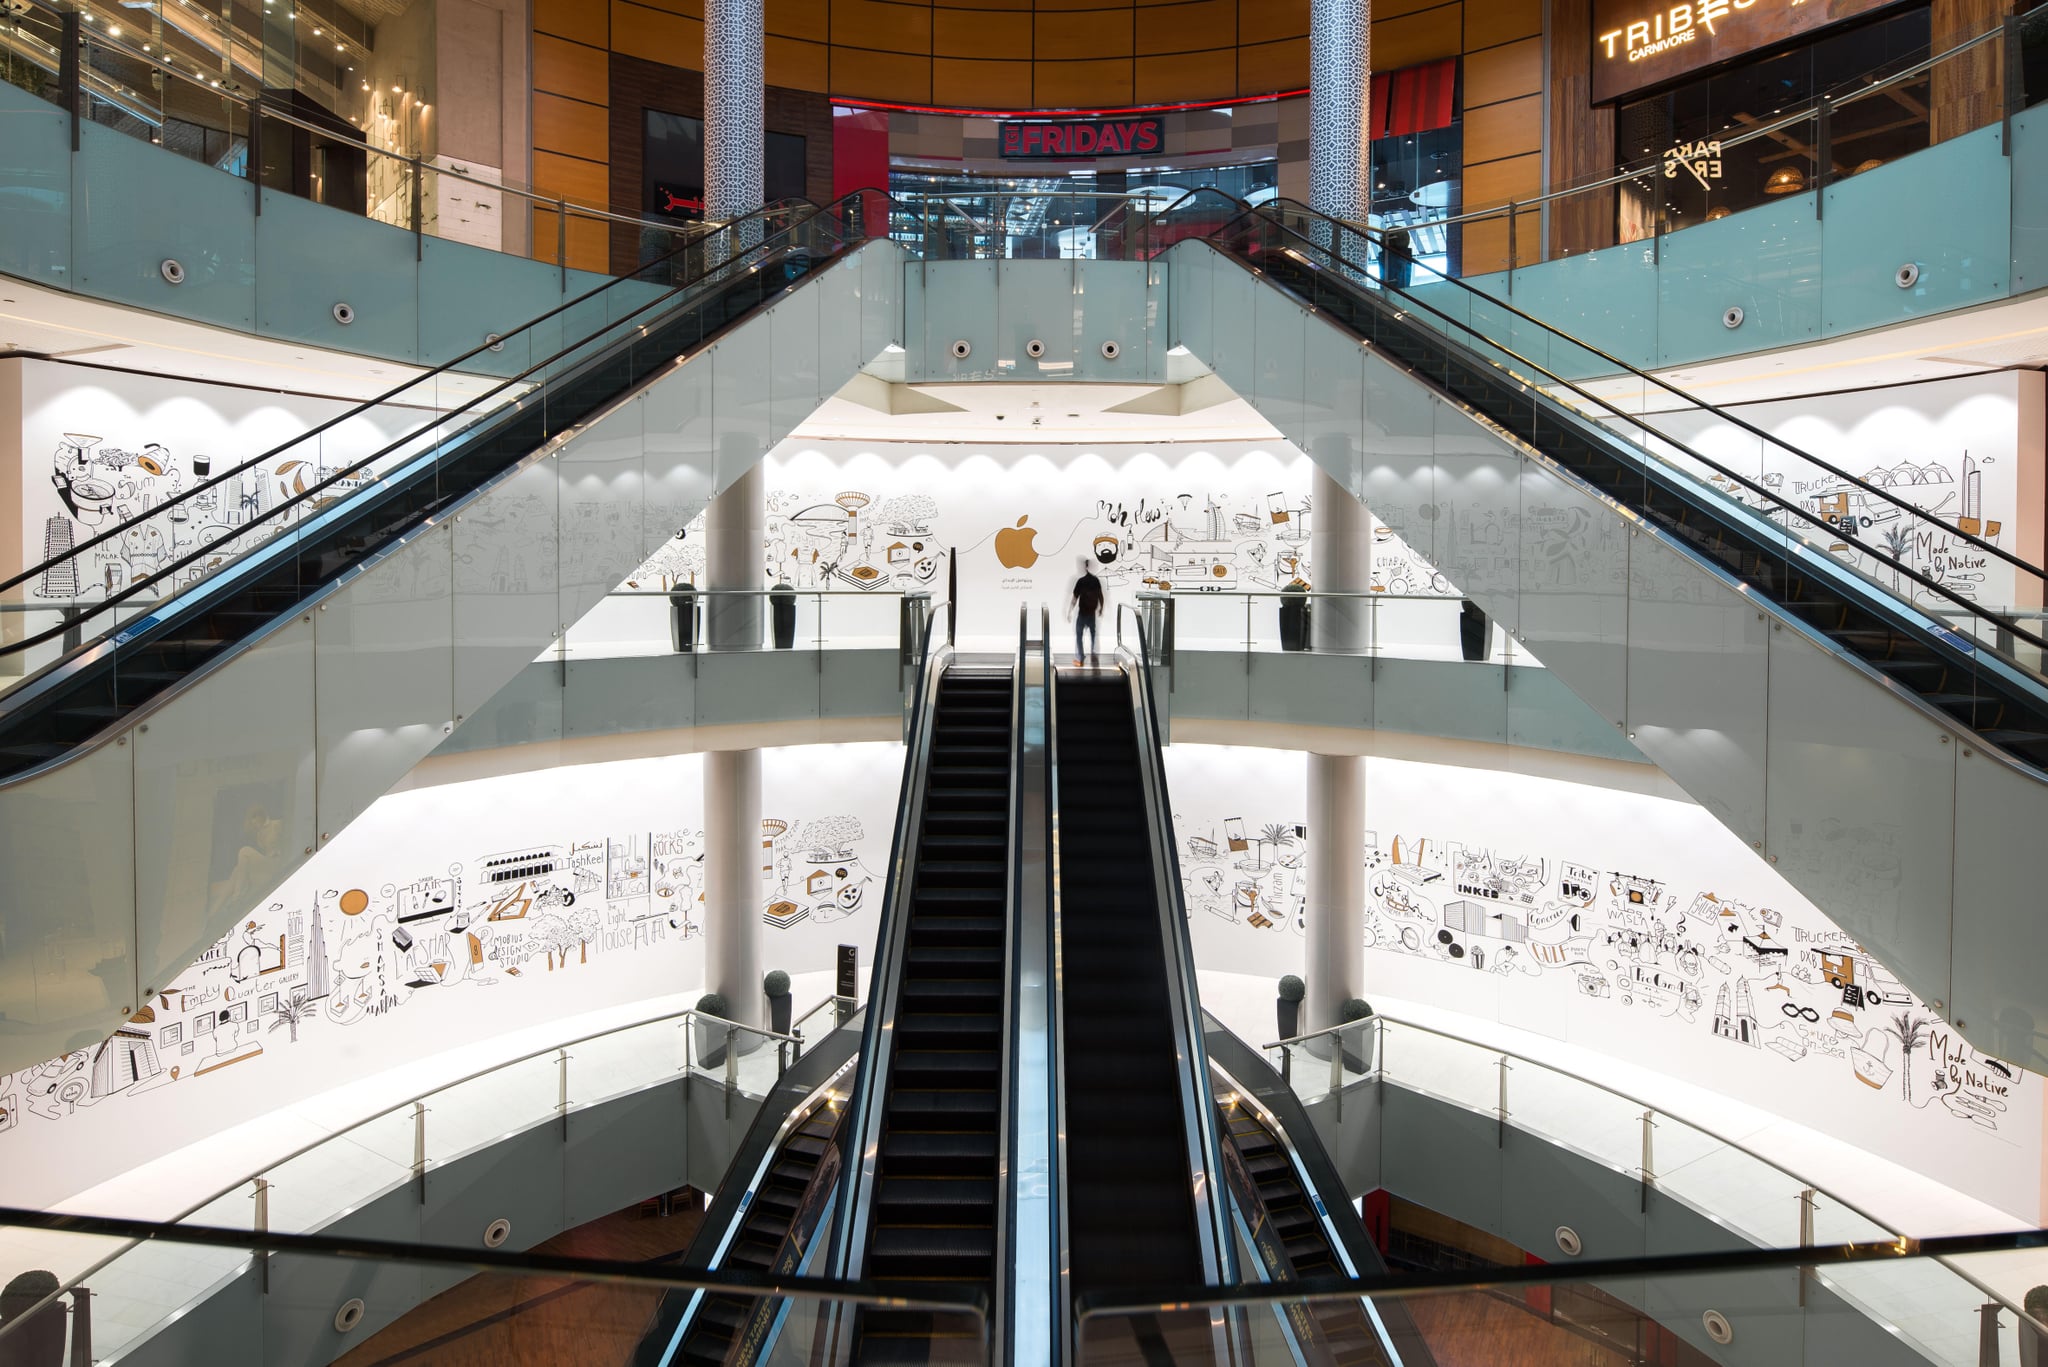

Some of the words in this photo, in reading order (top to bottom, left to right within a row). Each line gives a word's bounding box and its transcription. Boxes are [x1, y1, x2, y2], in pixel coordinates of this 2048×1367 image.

[1628, 28, 1696, 62] CARNIVORE
[1005, 126, 1019, 153] TGI
[1023, 121, 1158, 154] FRIDAYS
[1917, 531, 1949, 563] Made
[1948, 555, 1986, 570] Native
[1568, 866, 1593, 881] Tribe
[1457, 884, 1499, 899] INKED
[1800, 951, 1817, 969] DXB
[181, 984, 220, 1012] Empty
[224, 979, 275, 1001] Quarter
[1930, 1030, 1966, 1068] Made
[1966, 1069, 2009, 1097] Native
